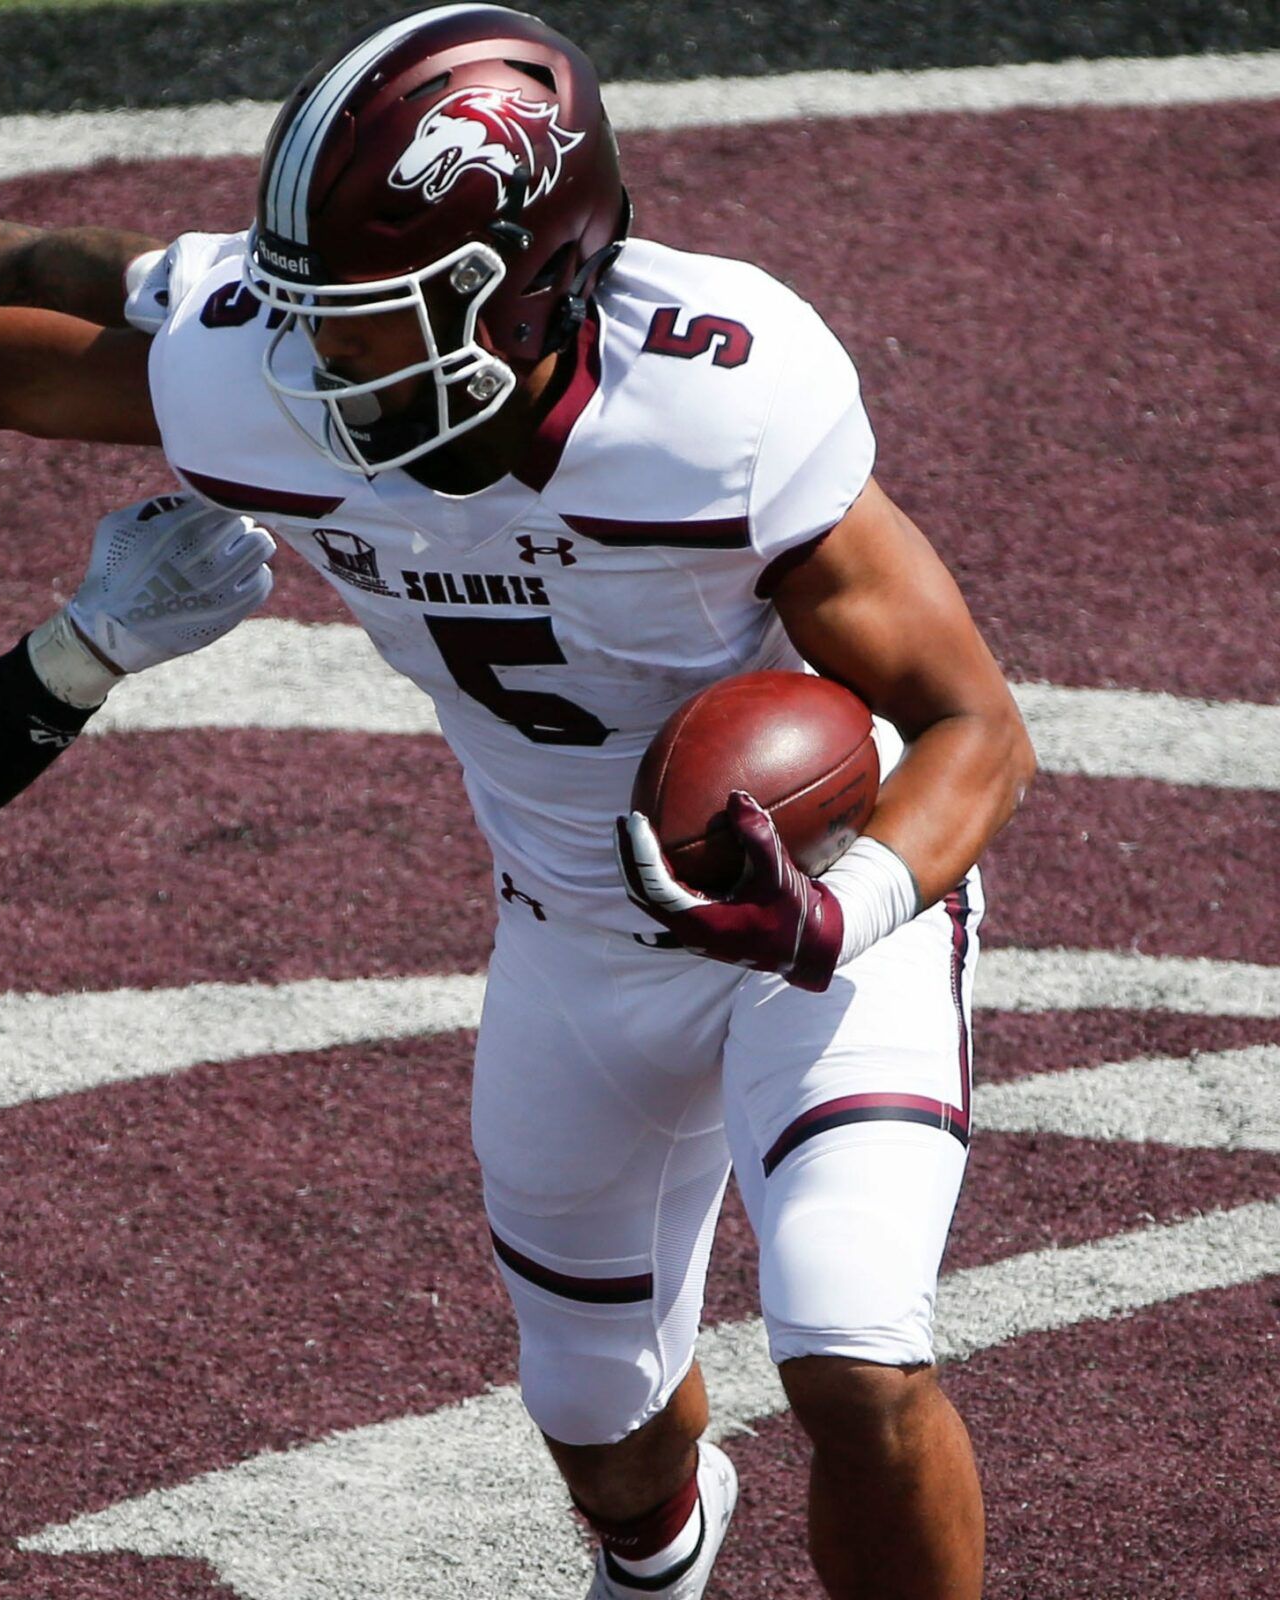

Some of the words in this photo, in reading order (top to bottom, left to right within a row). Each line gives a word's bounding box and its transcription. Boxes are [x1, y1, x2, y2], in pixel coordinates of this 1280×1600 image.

[642, 307, 754, 369] 5
[401, 570, 550, 605] SALUKIS
[423, 613, 613, 746] 5
